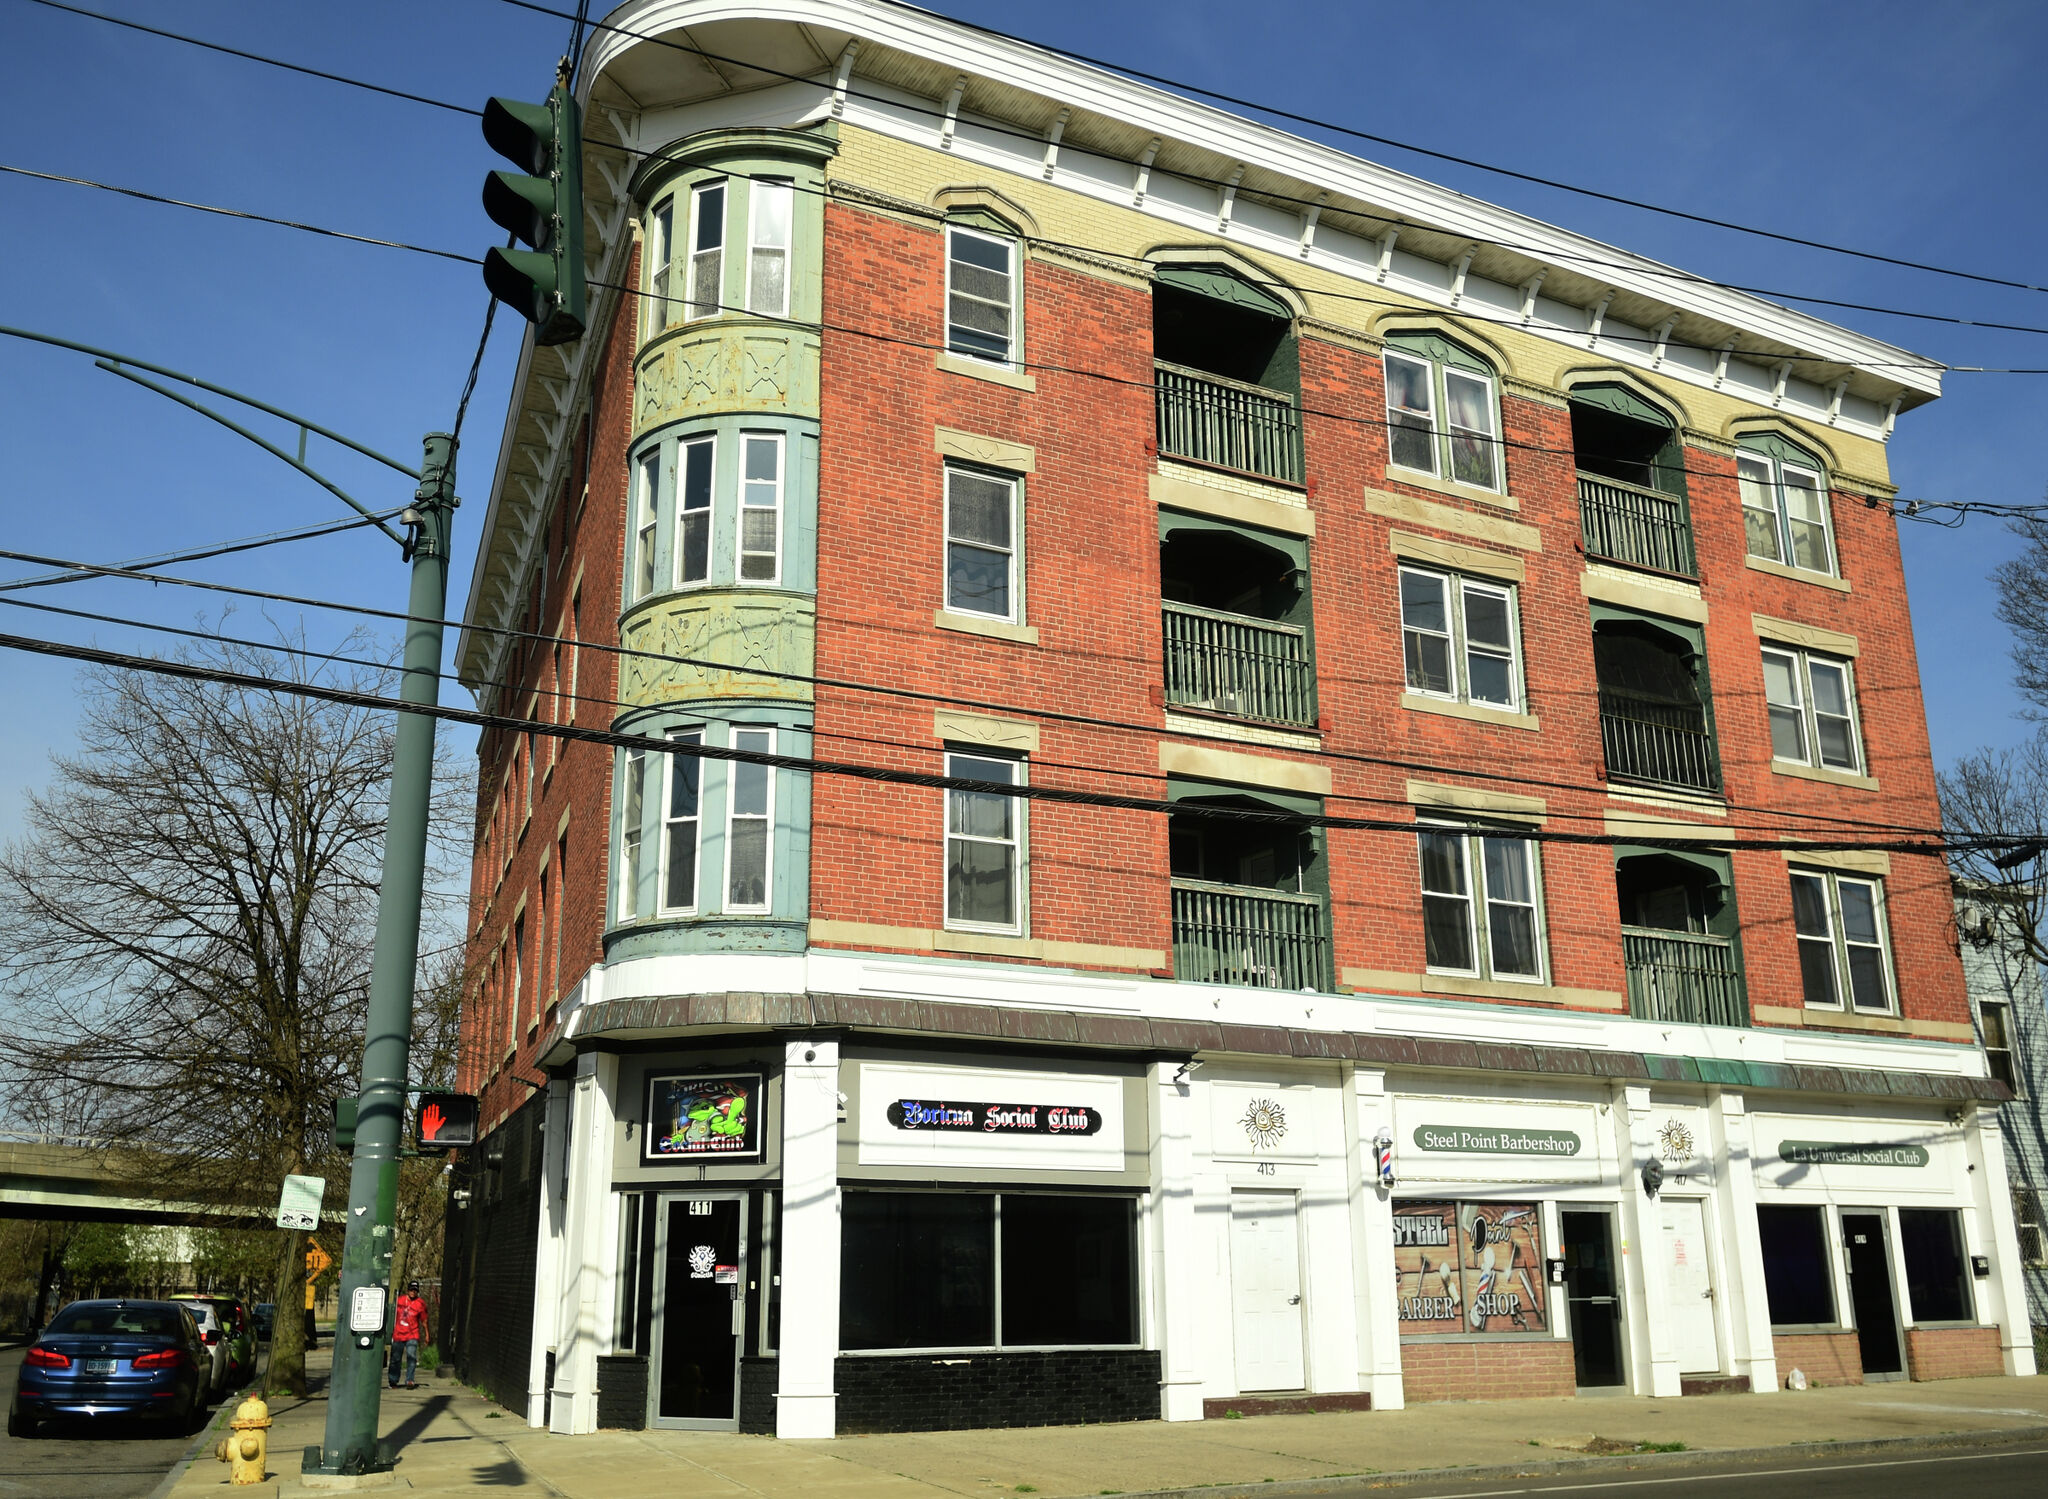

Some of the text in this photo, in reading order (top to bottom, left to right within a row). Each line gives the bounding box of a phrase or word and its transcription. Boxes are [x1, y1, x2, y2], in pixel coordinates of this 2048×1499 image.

[901, 1101, 1088, 1132] Boricua Social Club
[711, 1134, 744, 1151] Club
[1424, 1131, 1575, 1155] Steel Point Barbershop
[1792, 1146, 1920, 1165] La Universal Social Club
[1257, 1162, 1275, 1176] 413
[690, 1201, 711, 1214] 411
[1393, 1216, 1447, 1245] STEEL
[1470, 1215, 1511, 1254] Point
[1397, 1297, 1456, 1320] ARBER
[1477, 1294, 1519, 1316] SHOP
